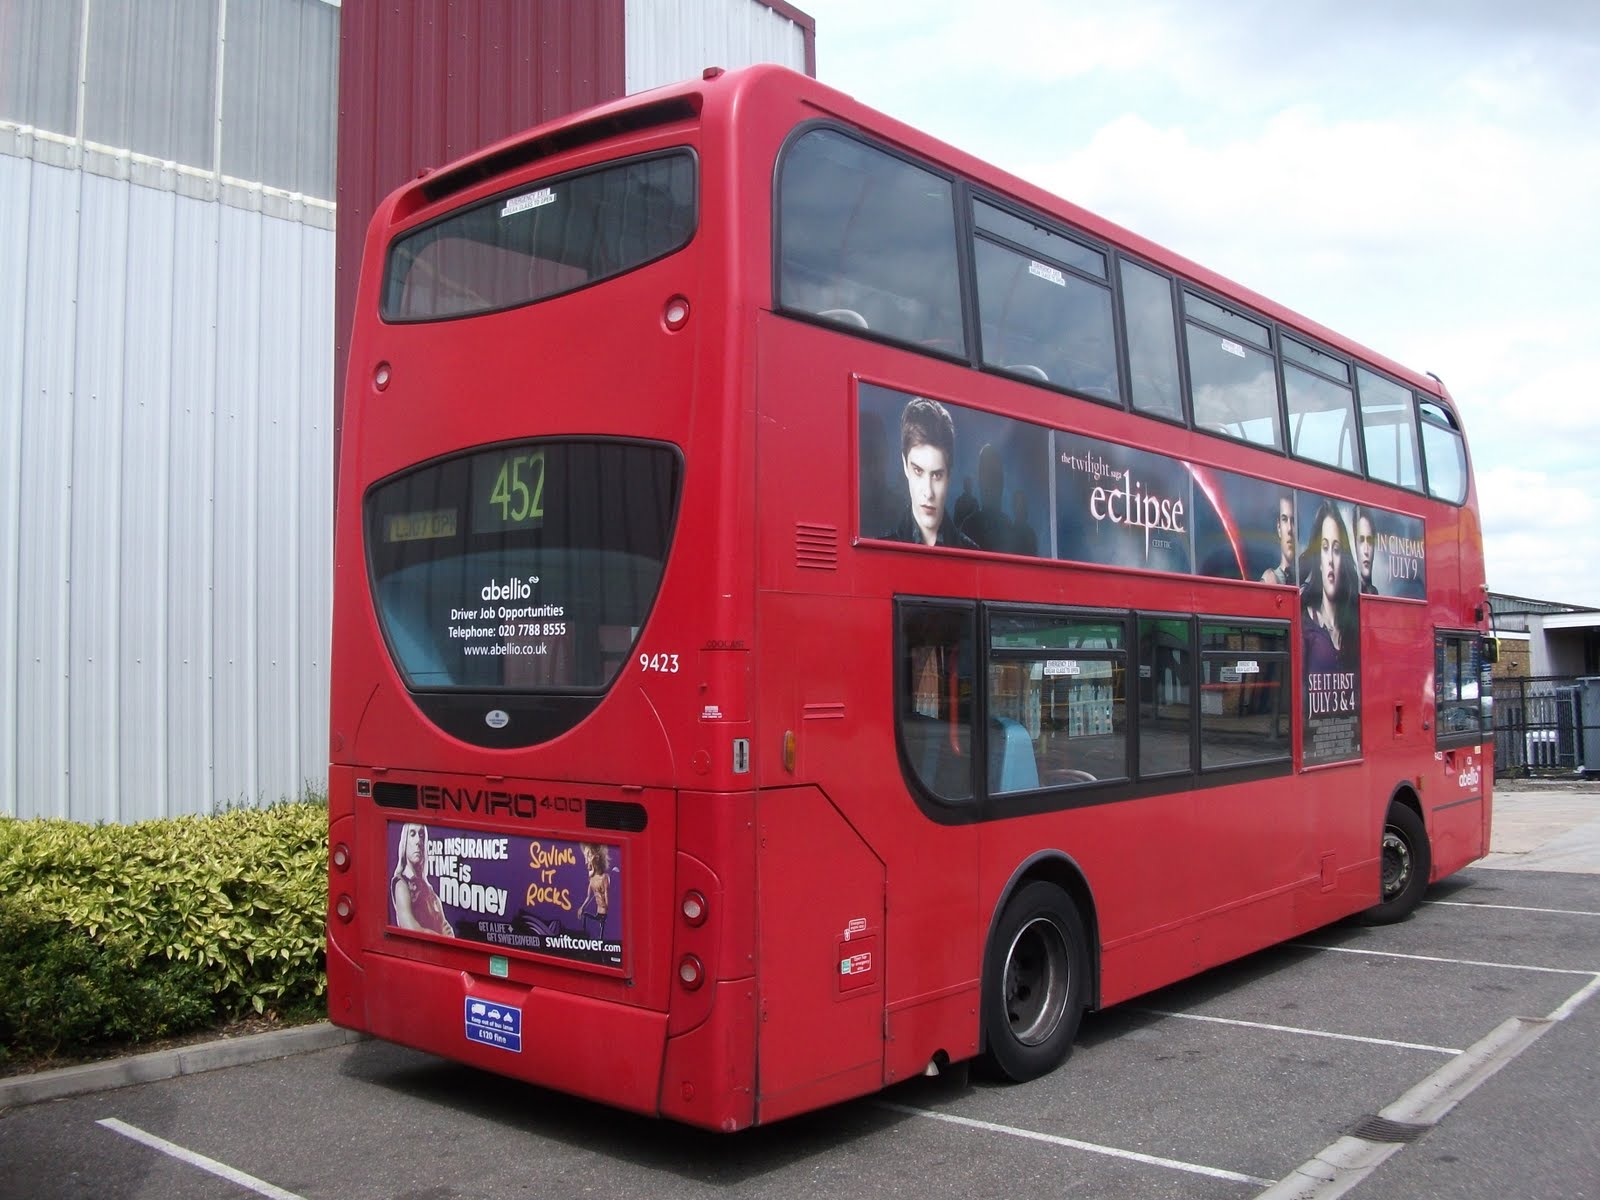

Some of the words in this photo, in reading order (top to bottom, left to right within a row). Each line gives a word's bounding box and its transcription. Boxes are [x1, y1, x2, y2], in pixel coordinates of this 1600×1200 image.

[1061, 452, 1070, 464] the
[1071, 450, 1110, 480] twilight
[1110, 471, 1122, 481] saga
[489, 451, 544, 521] 452
[1090, 469, 1186, 560] eclipse
[1376, 532, 1388, 552] IN
[1389, 536, 1424, 558] CINEMAS
[1388, 555, 1410, 582] JULY
[1412, 559, 1418, 580] 9
[481, 578, 531, 600] abellio
[450, 608, 478, 620] Driver
[479, 608, 496, 620] Job
[498, 604, 564, 620] Opportunities
[448, 626, 496, 639] Telephone:
[498, 624, 516, 636] 020
[518, 624, 540, 636] 7788
[543, 623, 566, 636] 8555
[464, 642, 548, 656] www.abellio.co.uk
[640, 654, 679, 673] 9423
[1308, 673, 1322, 690] SEE
[1324, 673, 1332, 690] IT
[1332, 672, 1354, 690] FIRST
[1308, 691, 1331, 719] JULY
[1332, 691, 1338, 712] 3
[1340, 690, 1348, 711] &
[1350, 690, 1355, 710] 4
[420, 786, 538, 818] ENVIRO
[540, 796, 583, 813] 400
[427, 840, 444, 856] CAR
[444, 838, 508, 860] INSURANCE
[428, 856, 458, 878] TIME
[542, 869, 556, 884] IT
[526, 883, 572, 910] ROCKS
[478, 922, 490, 932] GET
[490, 922, 494, 933] A
[495, 923, 506, 934] LIFE
[486, 932, 497, 942] GET
[498, 933, 540, 947] SWIFTCOVERED
[545, 934, 621, 952] swiftcover.com
